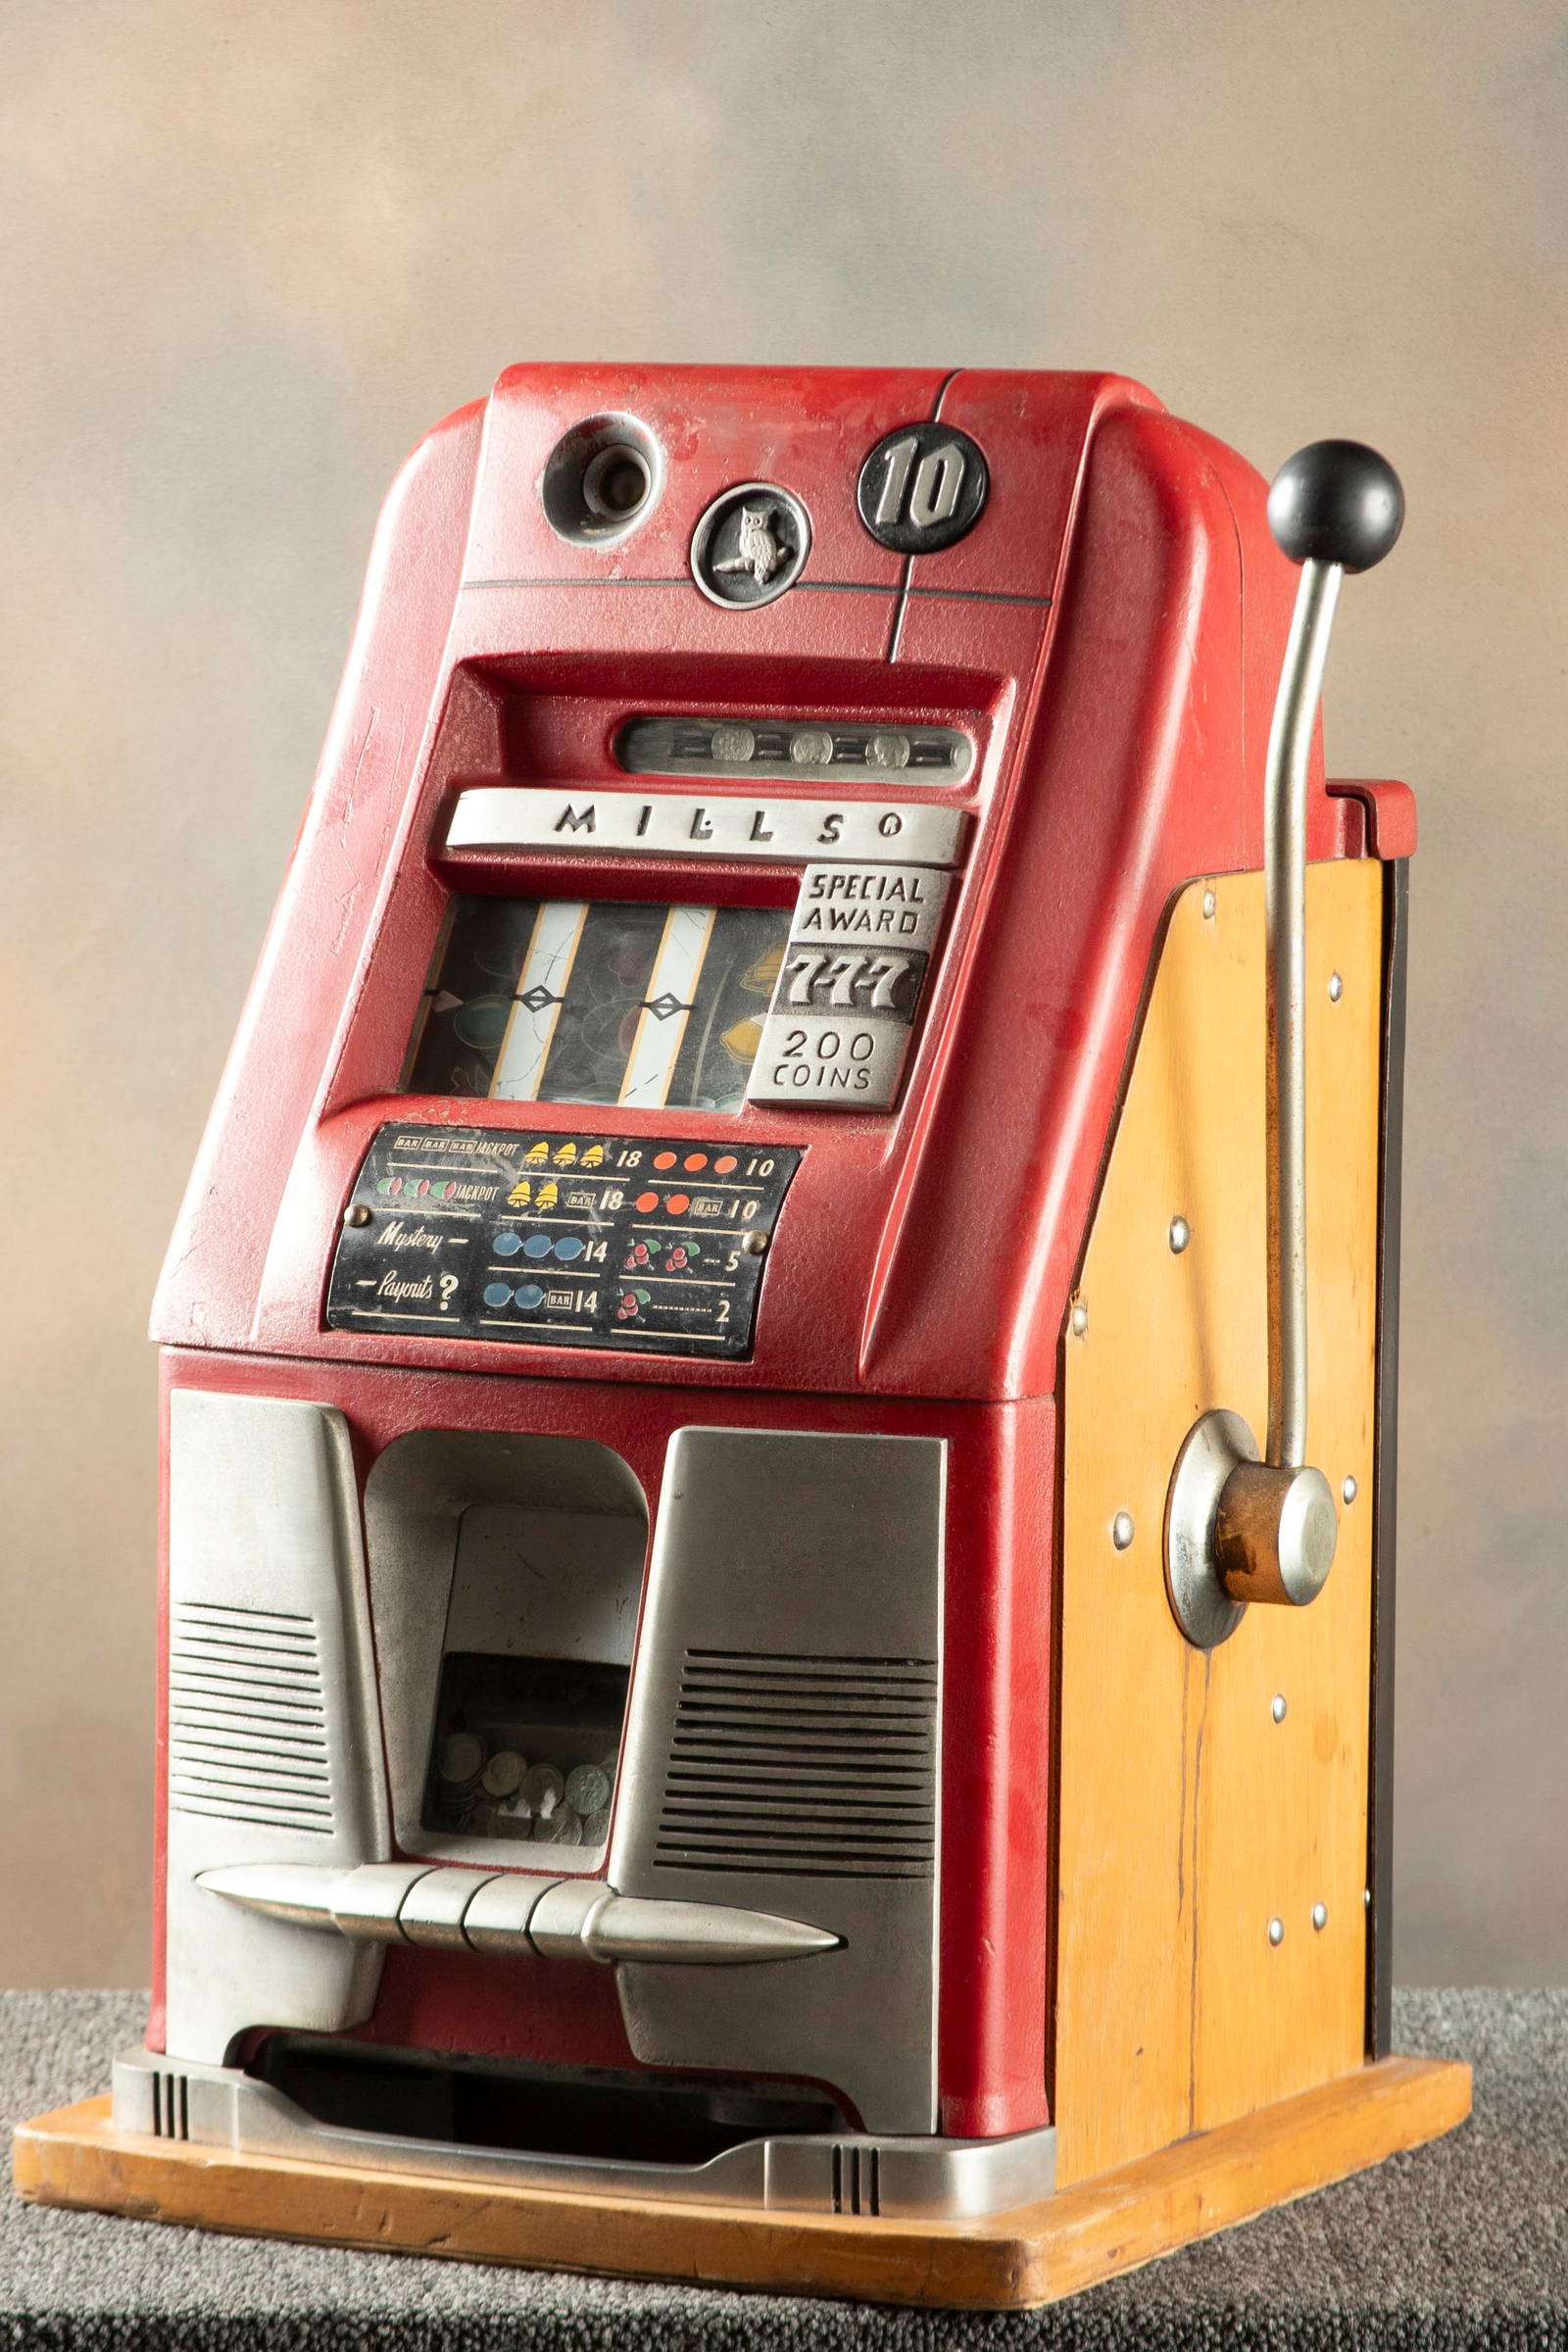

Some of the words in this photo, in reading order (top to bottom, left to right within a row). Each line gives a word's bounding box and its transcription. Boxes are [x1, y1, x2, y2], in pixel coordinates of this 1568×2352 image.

[875, 436, 965, 527] 10
[554, 804, 845, 845] MILLS
[808, 873, 925, 904] SPECIAL
[802, 907, 920, 935] AWARD
[782, 1029, 875, 1061] 200
[772, 1063, 872, 1090] COINS
[396, 1137, 419, 1149] BAR
[422, 1138, 447, 1150] BAR
[450, 1141, 475, 1152] BAR
[475, 1141, 519, 1156] JACKPOT
[616, 1150, 643, 1168] 18
[746, 1158, 775, 1177] 10
[455, 1185, 500, 1201] JACKPOT
[568, 1194, 594, 1207] BAR
[599, 1190, 624, 1210] 18
[695, 1202, 720, 1215] BAR
[729, 1199, 759, 1220] 10
[376, 1221, 444, 1254] Mystery
[584, 1240, 609, 1262] 14
[725, 1250, 741, 1271] 5
[549, 1294, 571, 1307] BAR
[575, 1290, 598, 1313] 14
[715, 1299, 730, 1323] 2
